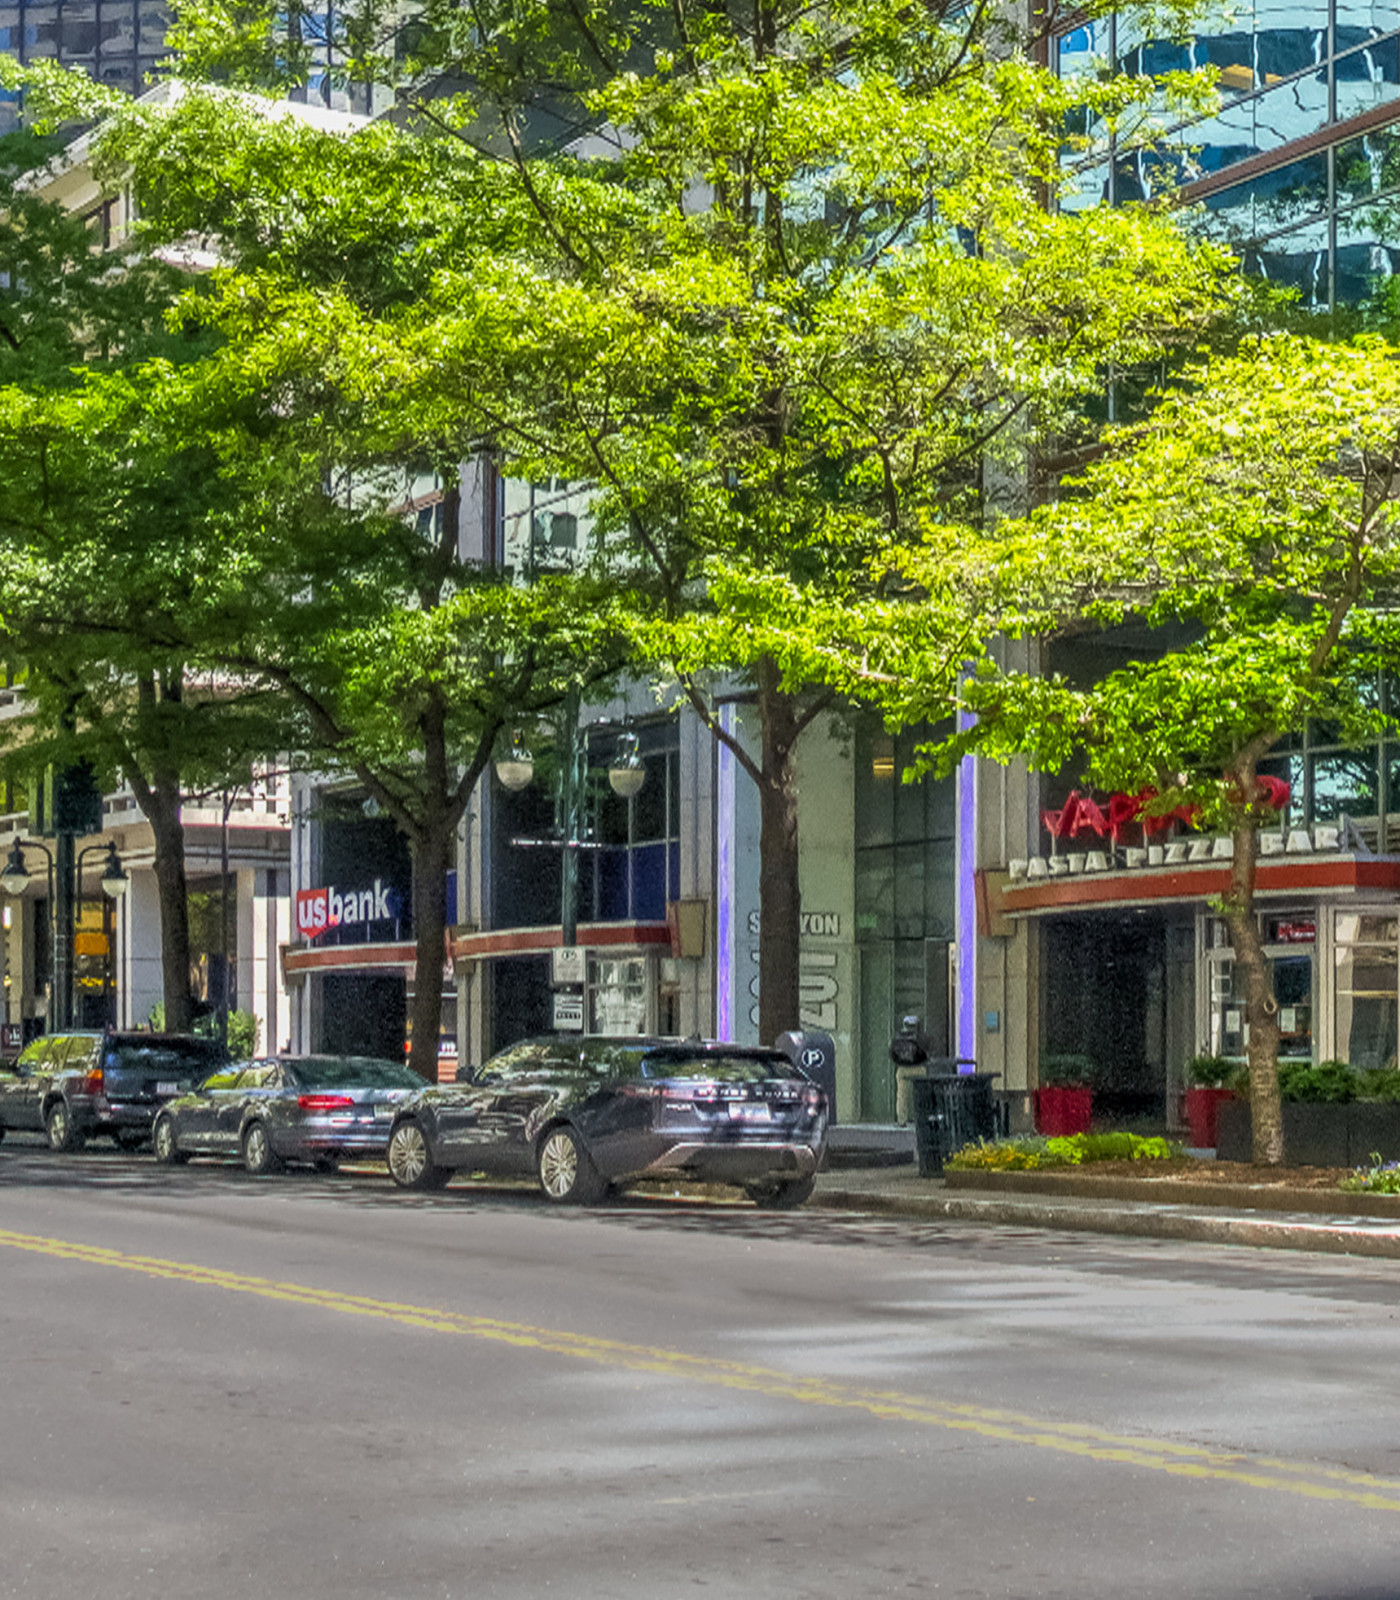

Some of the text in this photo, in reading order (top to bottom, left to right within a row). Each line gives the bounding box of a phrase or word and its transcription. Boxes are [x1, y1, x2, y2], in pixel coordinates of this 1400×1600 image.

[1008, 826, 1340, 881] PASTA PIZZA BAR
